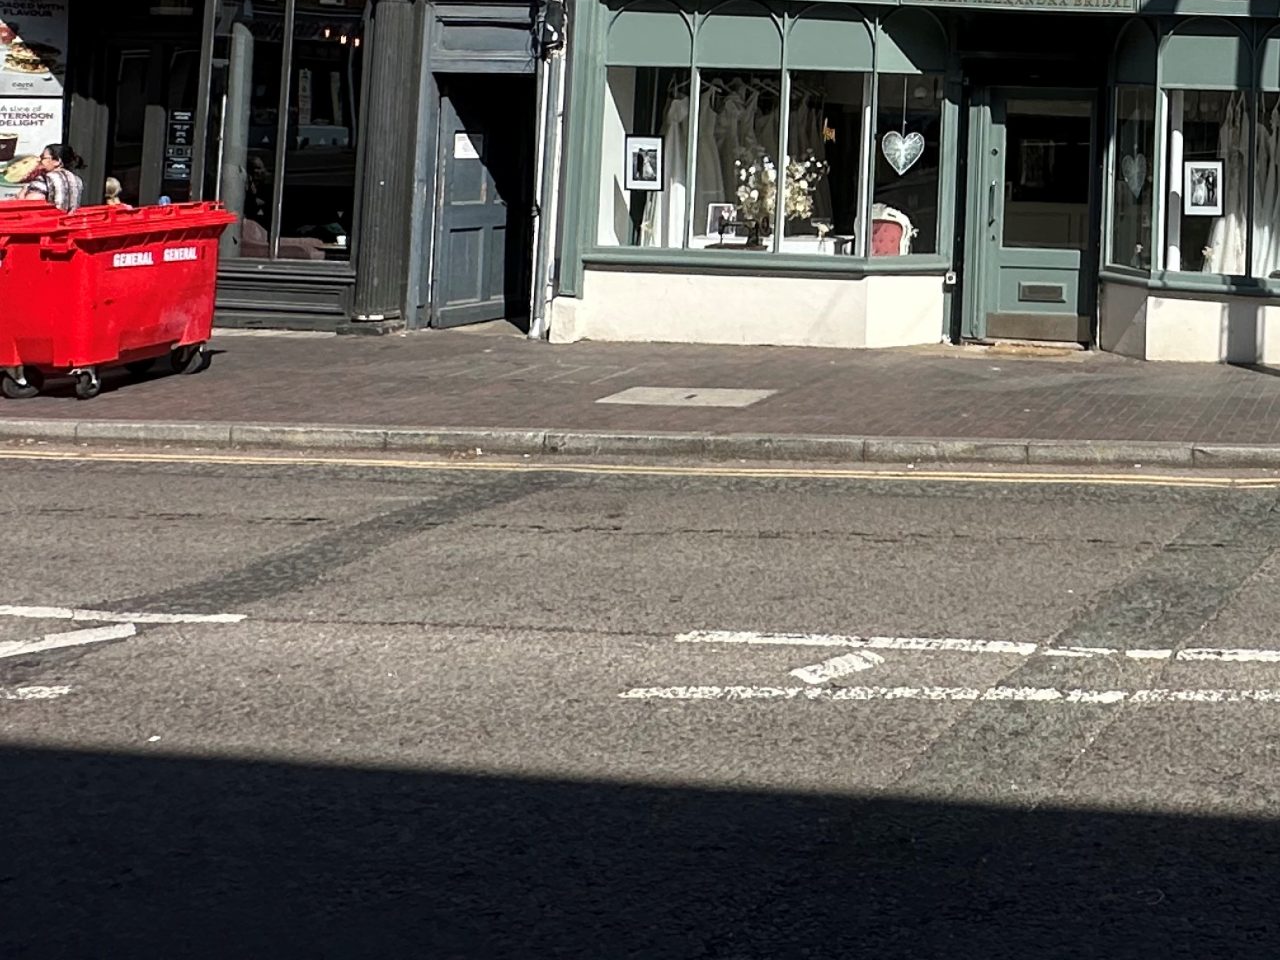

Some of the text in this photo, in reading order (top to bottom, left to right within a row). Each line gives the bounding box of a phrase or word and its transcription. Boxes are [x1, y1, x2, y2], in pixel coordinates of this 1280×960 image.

[3, 8, 53, 17] FLAVOUR
[0, 112, 54, 120] TERNOON
[0, 119, 45, 127] DELIGHT
[163, 247, 197, 262] GENERAL
[113, 252, 154, 268] GENERAL
